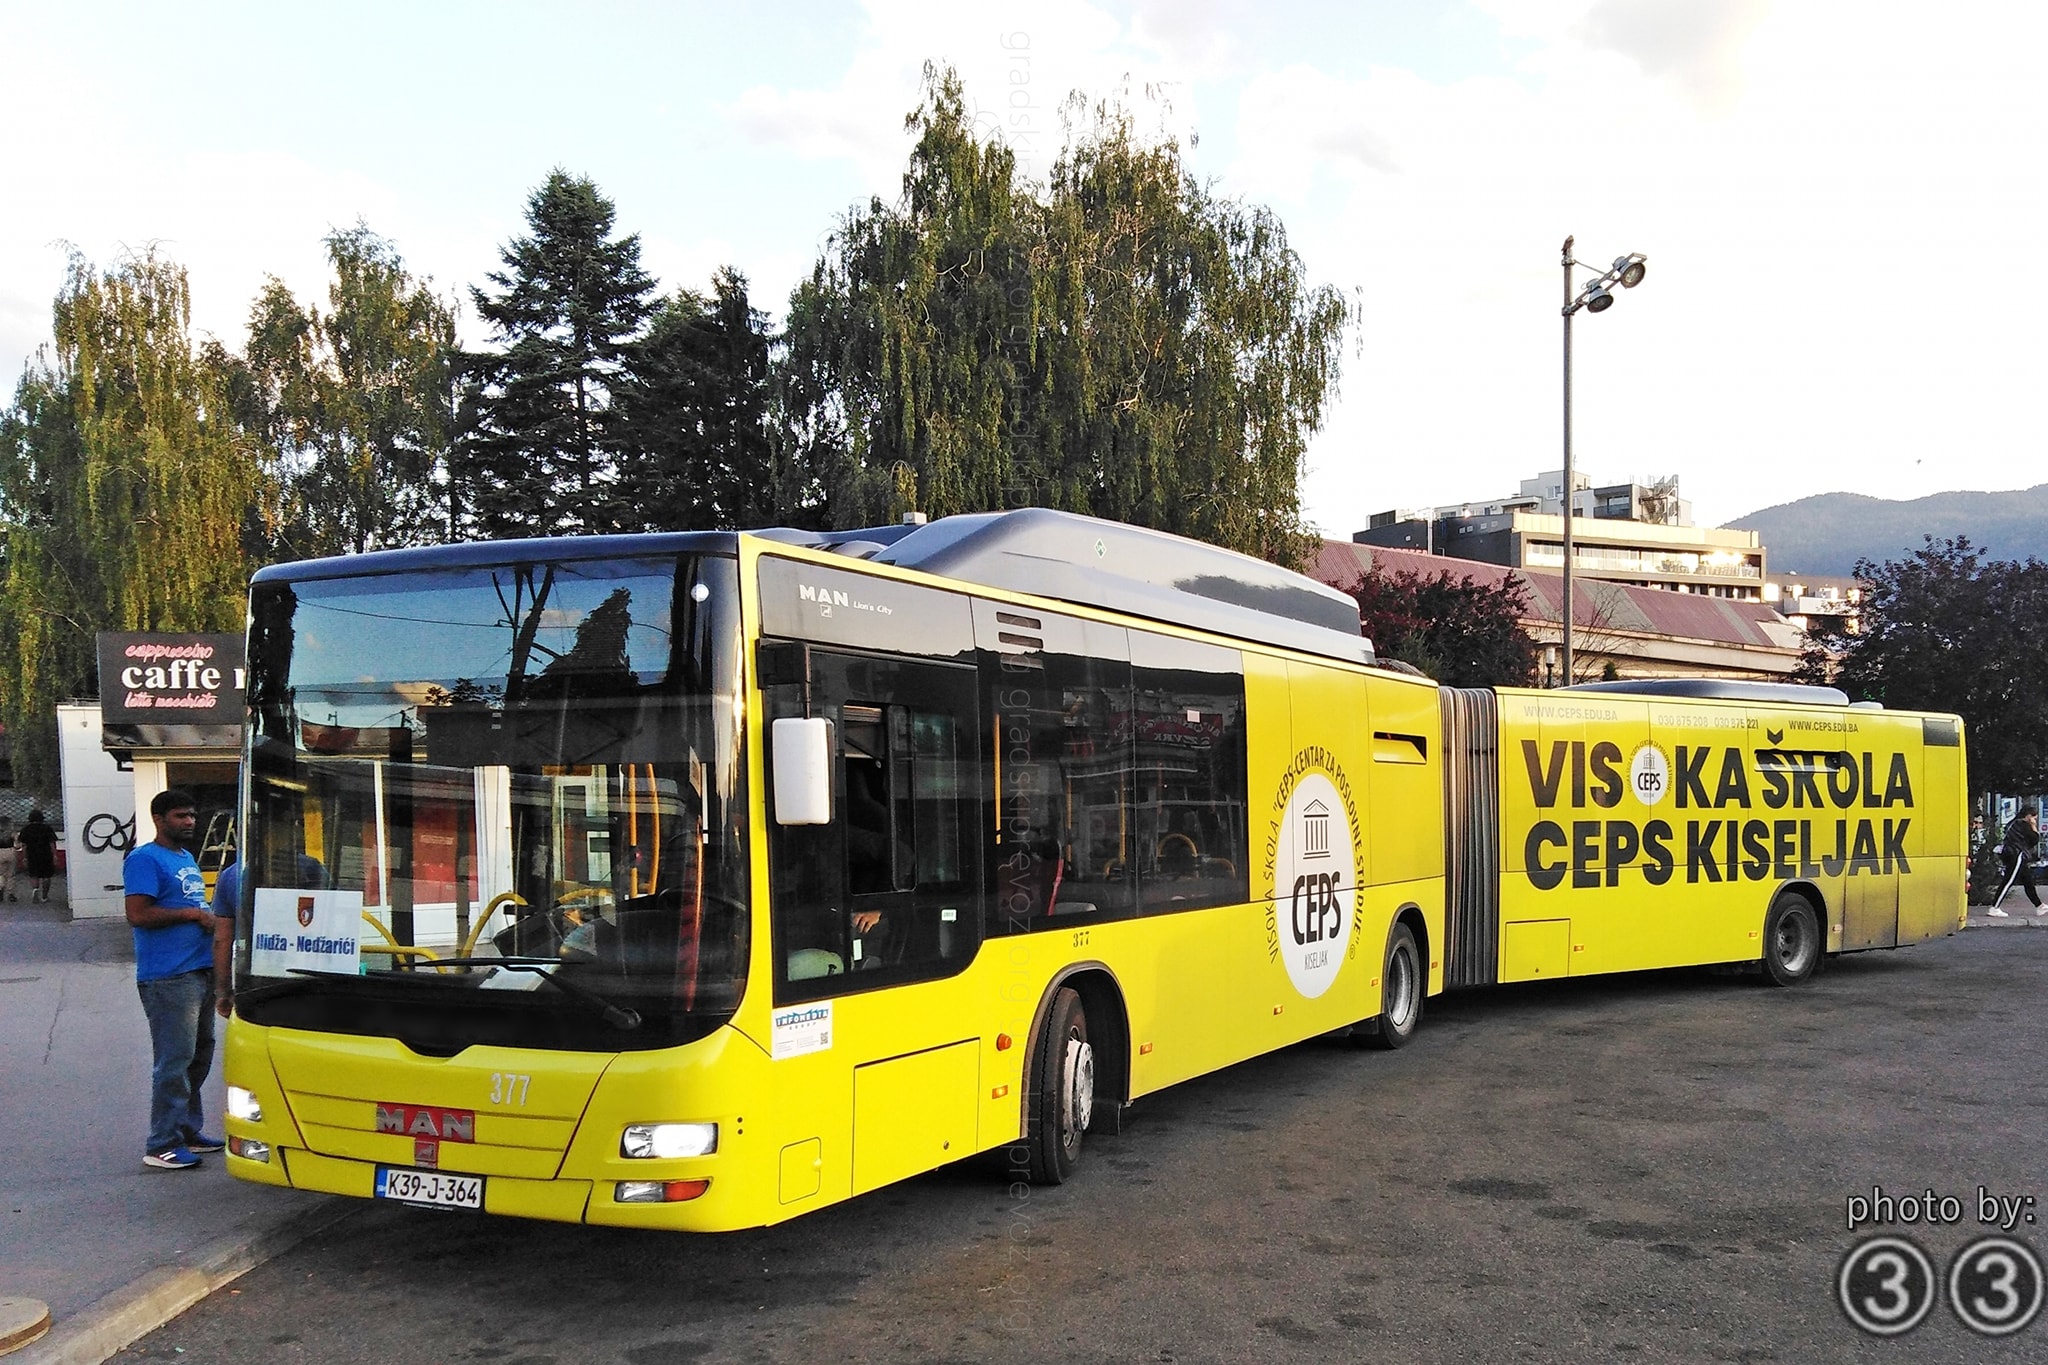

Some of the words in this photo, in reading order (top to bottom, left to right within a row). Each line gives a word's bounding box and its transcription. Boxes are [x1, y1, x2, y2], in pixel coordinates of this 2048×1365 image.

[799, 584, 849, 607] MAN
[853, 601, 874, 611] Lion's
[877, 604, 893, 615] City
[125, 643, 214, 662] cappuccino
[121, 659, 222, 690] caffe
[155, 692, 218, 709] macchiato
[1524, 705, 1618, 721] WWW.CEPS.EDU.BA
[1658, 715, 1674, 726] 030
[1747, 718, 1759, 729] 221
[1788, 720, 1859, 733] WWW.CEPS.EDU.BA
[1325, 751, 1335, 781] ZA
[1637, 772, 1661, 791] CEPS
[1756, 728, 1914, 808] ŠKOLA
[1335, 763, 1364, 852] POSLOVNE
[1263, 820, 1280, 879] ŠKOLA
[1524, 819, 1675, 891] CEPS
[1686, 817, 1912, 885] KISELJAK
[1292, 871, 1341, 946] CEPS
[1073, 931, 1090, 948] 377
[1264, 888, 1279, 963] VISOKA
[256, 932, 288, 952] Ilidža
[296, 935, 355, 955] Nedžarići
[1304, 949, 1329, 971] KISELJAK
[490, 1072, 531, 1106] 377
[376, 1106, 474, 1140] MAN
[388, 1173, 478, 1204] K39-J-364
